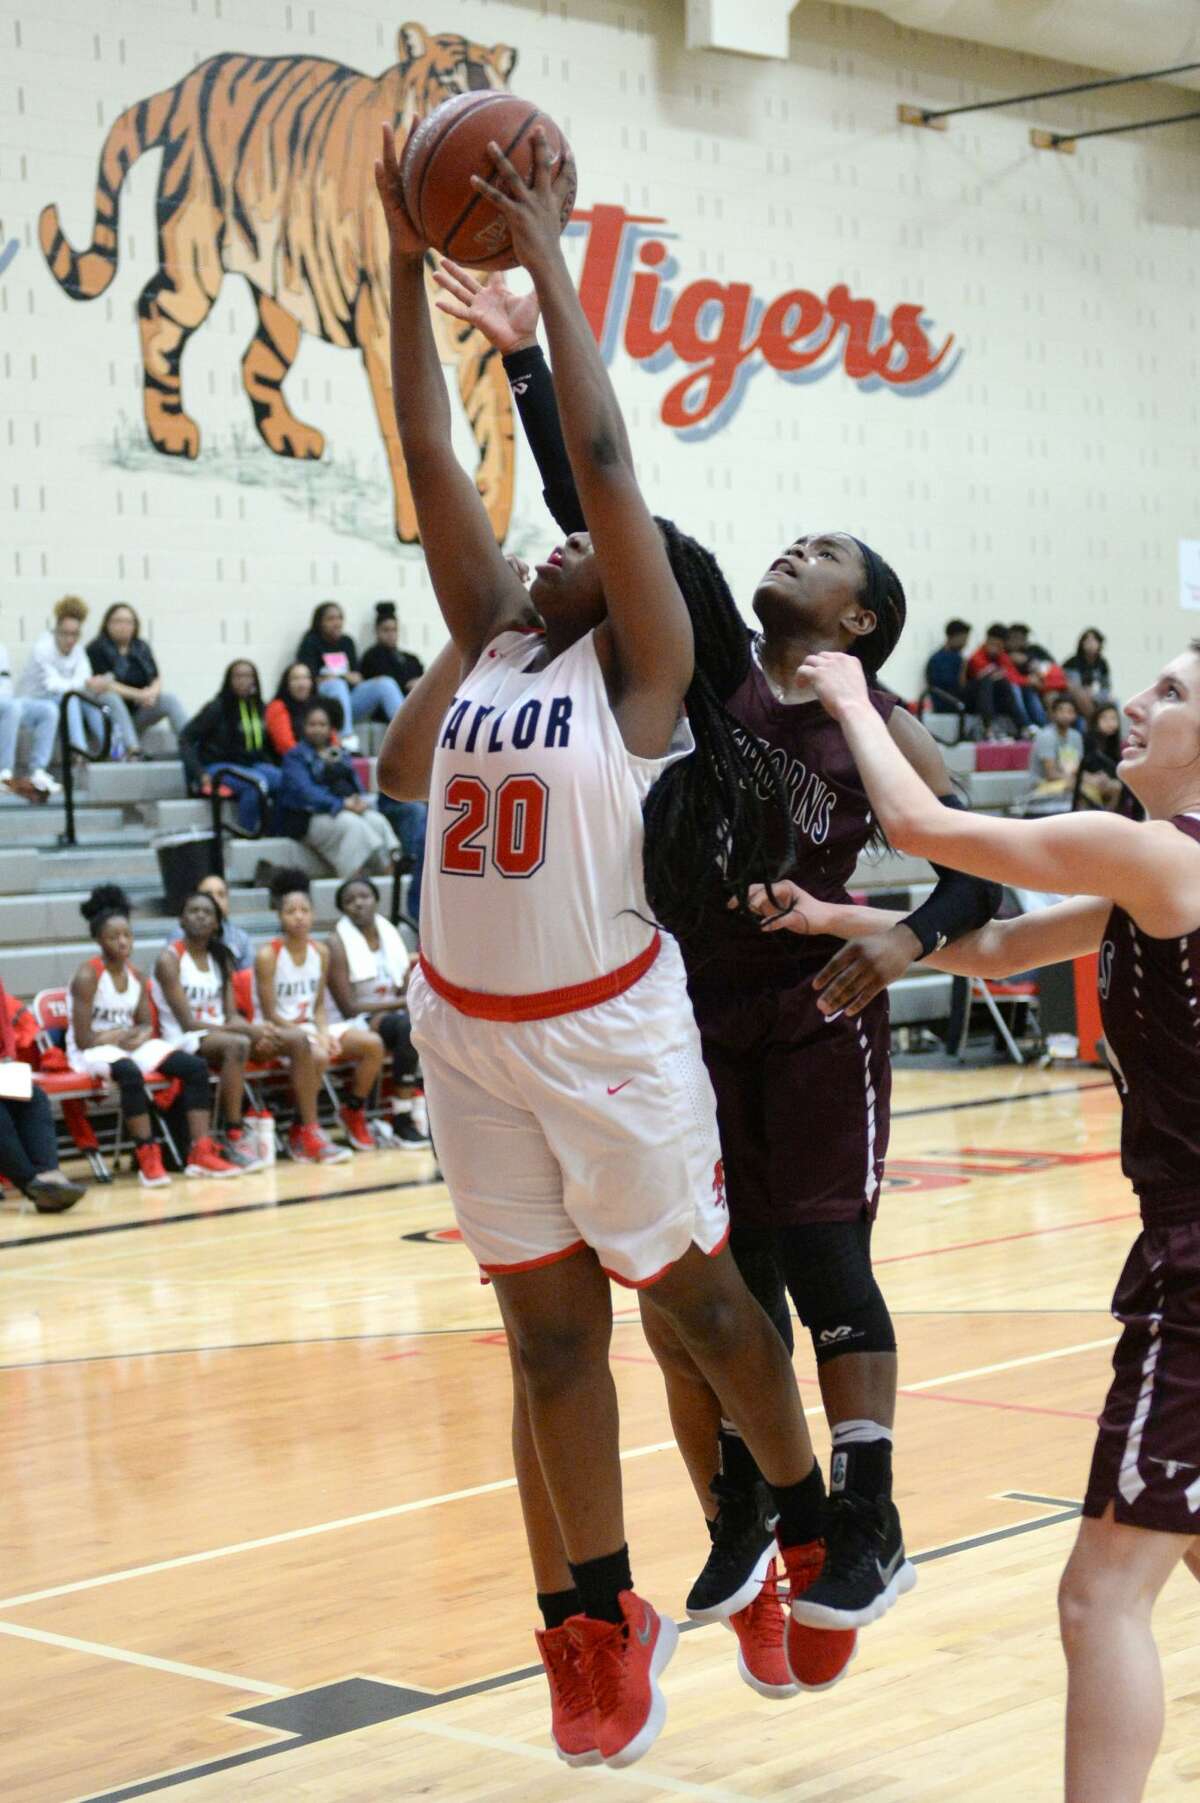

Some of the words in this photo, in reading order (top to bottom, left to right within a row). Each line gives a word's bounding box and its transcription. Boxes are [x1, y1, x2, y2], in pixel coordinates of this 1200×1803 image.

[570, 203, 957, 430] Tigers
[441, 695, 573, 753] AYLOR
[440, 772, 549, 878] 20
